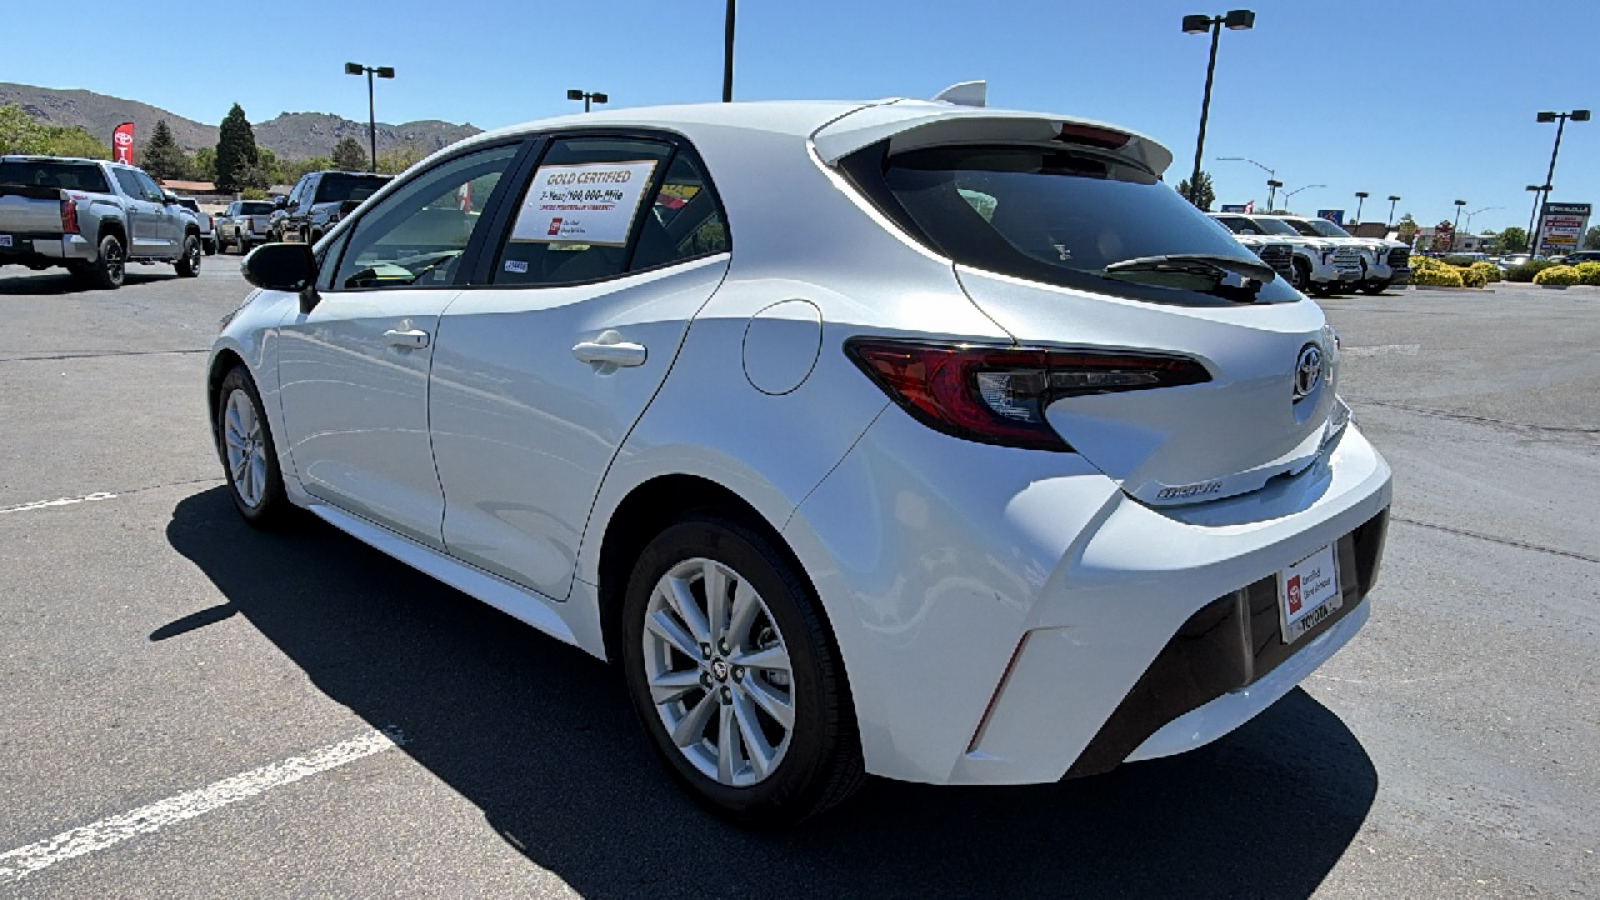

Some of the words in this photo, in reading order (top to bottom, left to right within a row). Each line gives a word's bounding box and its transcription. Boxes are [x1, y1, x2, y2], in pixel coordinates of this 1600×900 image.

[547, 172, 576, 186] GOLD
[577, 170, 631, 184] CERTIFIED
[1300, 603, 1328, 631] TOYOTA
